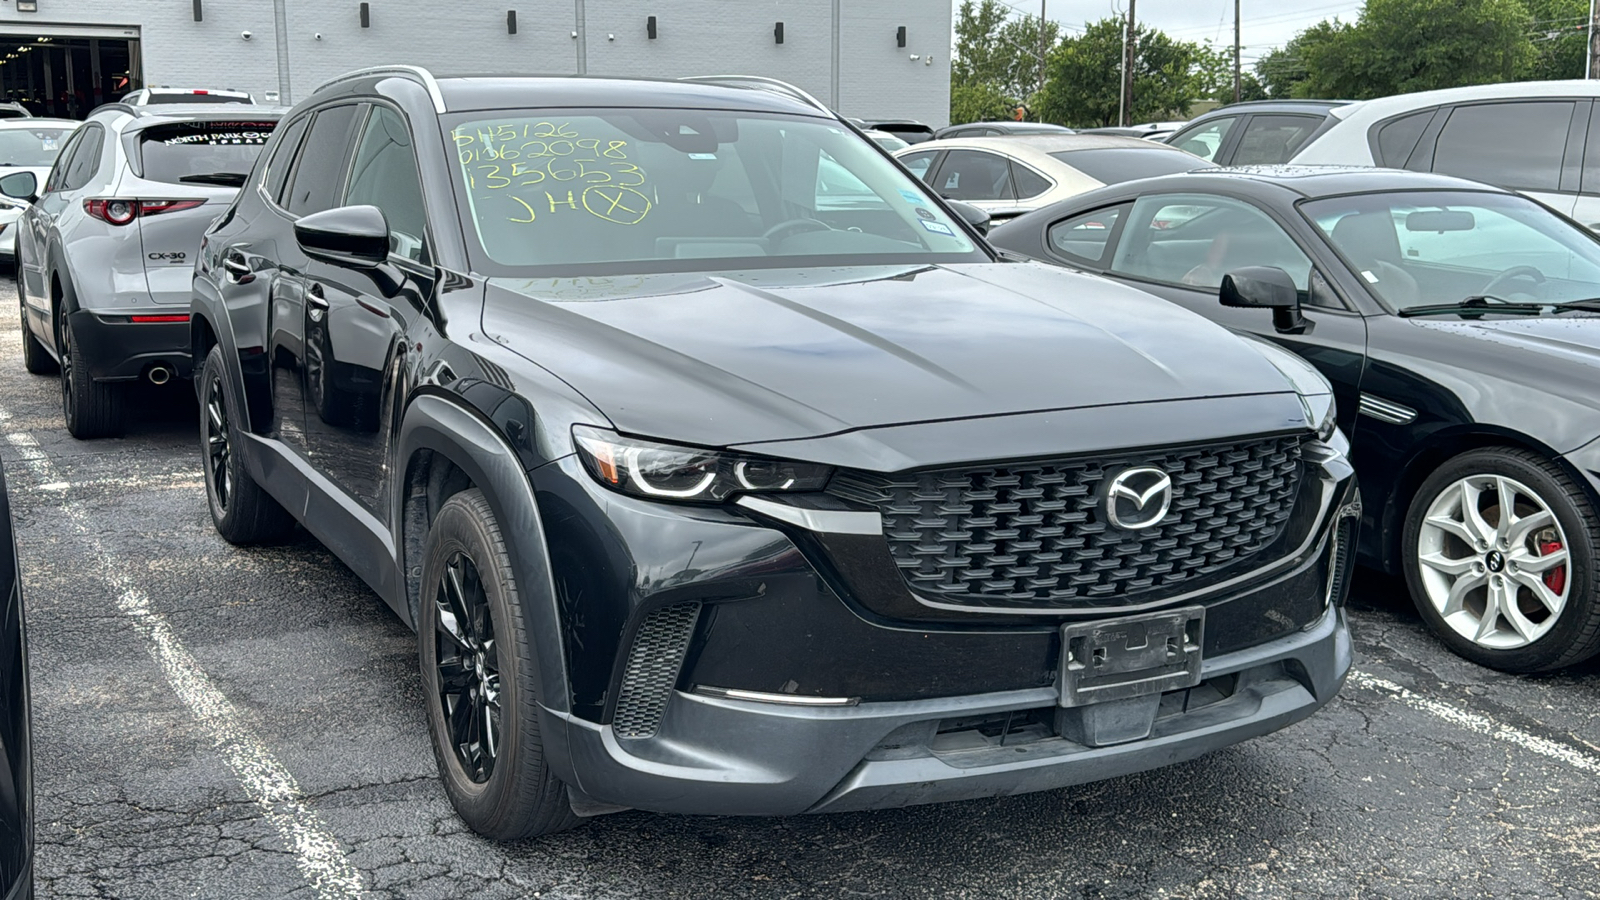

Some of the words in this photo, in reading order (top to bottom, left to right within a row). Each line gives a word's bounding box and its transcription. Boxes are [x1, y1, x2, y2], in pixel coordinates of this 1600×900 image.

[164, 133, 209, 147] NORTH
[211, 132, 243, 140] PARK
[466, 157, 645, 189] 135653
[148, 252, 186, 260] CX-30
